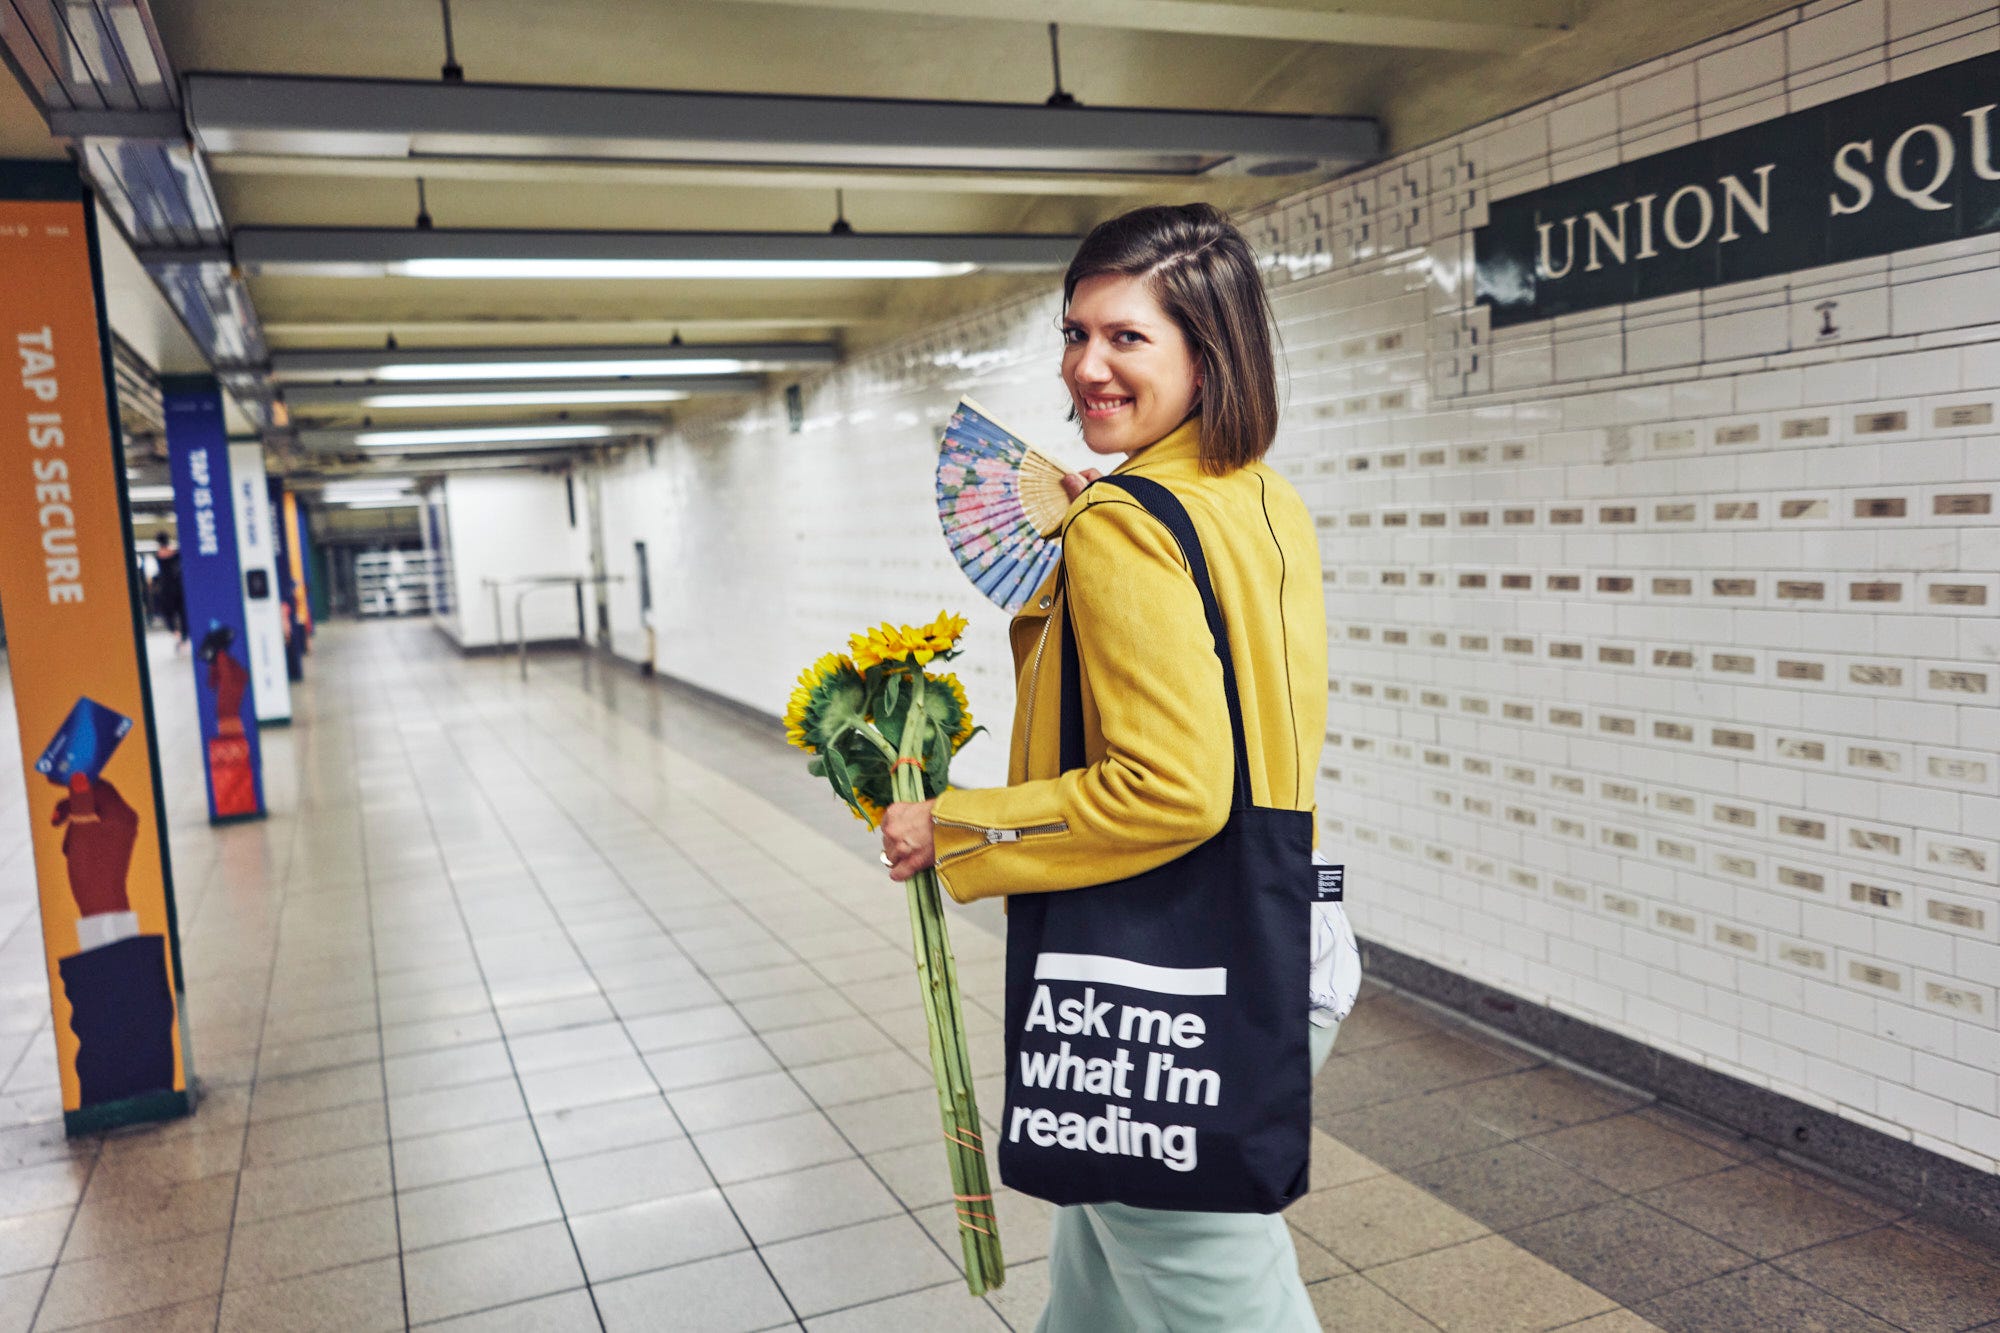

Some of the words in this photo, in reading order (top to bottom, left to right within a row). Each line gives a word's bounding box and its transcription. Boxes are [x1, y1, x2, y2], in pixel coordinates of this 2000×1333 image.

[1537, 163, 1776, 280] UNION
[17, 326, 58, 401] TAP
[27, 413, 64, 450] IS
[189, 448, 210, 486] TAP
[193, 487, 212, 509] IS
[33, 458, 84, 604] SECURE
[1024, 984, 1115, 1038] Ask
[1118, 1004, 1206, 1049] me
[1020, 1041, 1135, 1098] what
[1143, 1051, 1221, 1106] I'm
[1008, 1103, 1198, 1172] reading
